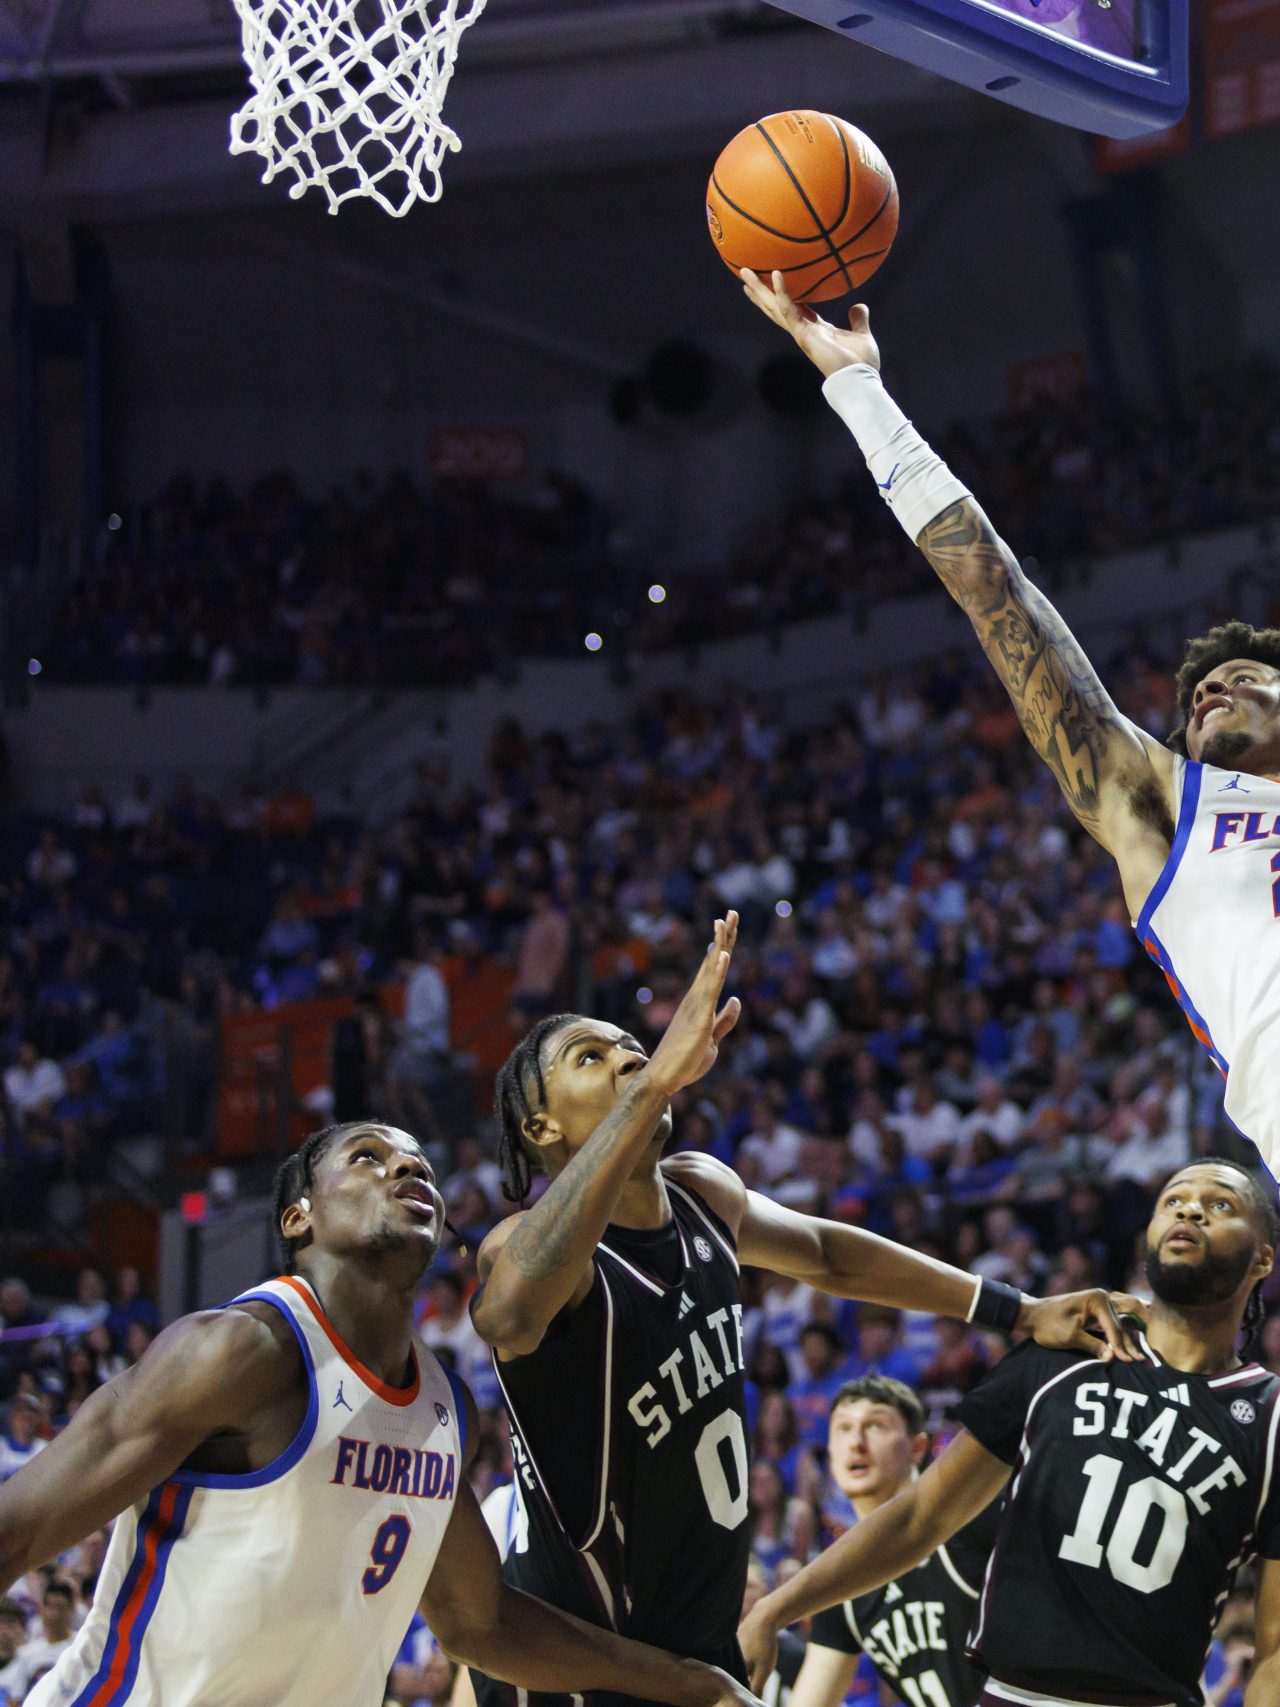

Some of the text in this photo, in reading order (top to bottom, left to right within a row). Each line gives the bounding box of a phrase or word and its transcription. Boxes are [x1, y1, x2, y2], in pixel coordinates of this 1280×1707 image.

[329, 1436, 455, 1501] FLORIDA
[694, 1407, 749, 1531] 0
[1073, 1382, 1248, 1516] STATE
[361, 1514, 412, 1595] 9
[1058, 1453, 1190, 1594] 10
[862, 1600, 948, 1678] STATE
